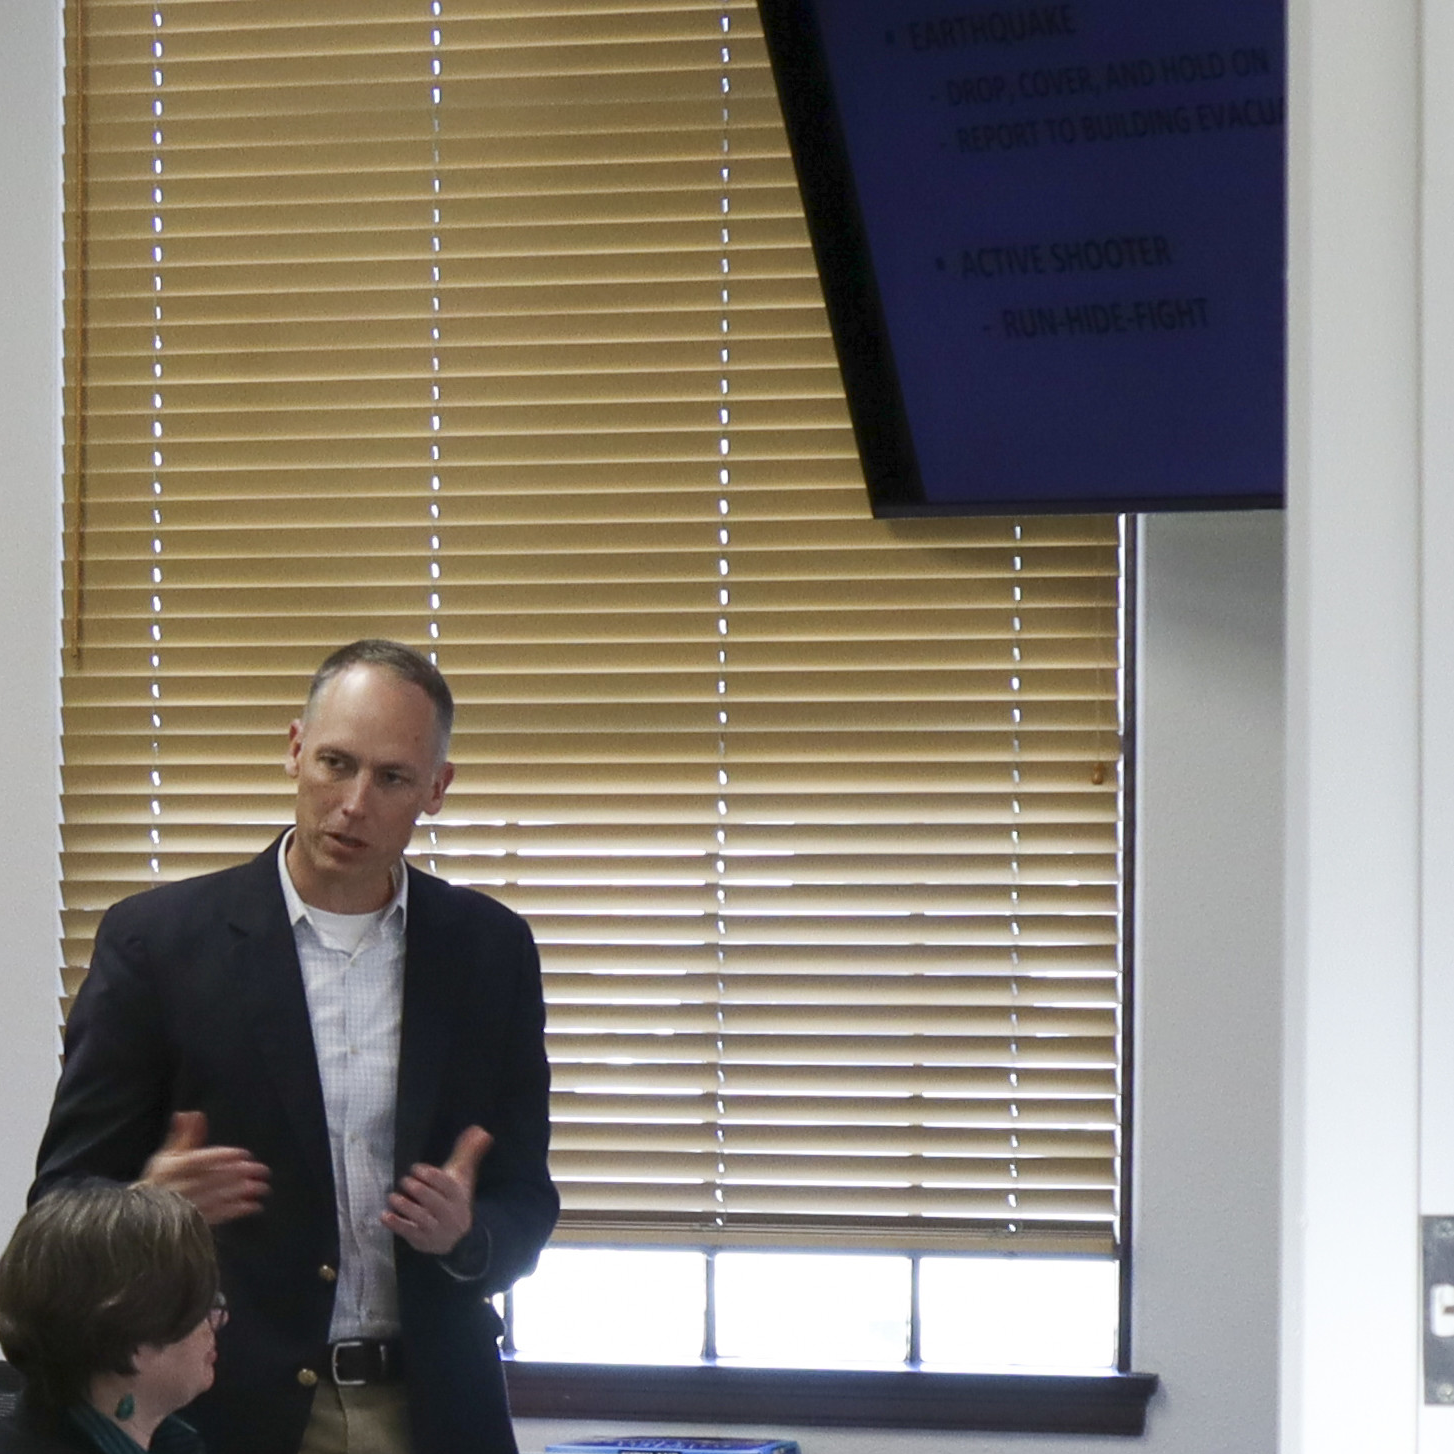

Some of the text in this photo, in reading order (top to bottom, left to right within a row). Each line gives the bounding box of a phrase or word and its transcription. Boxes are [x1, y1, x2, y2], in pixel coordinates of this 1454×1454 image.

[908, 4, 1077, 51] EARTHQUAKE
[946, 47, 1270, 106] DROP, COVER, AND HOLD ON
[957, 119, 1040, 152] REPORT
[1043, 115, 1077, 144] TO
[1081, 106, 1191, 143] BUILDING
[960, 235, 1174, 280] ACTIVE SHOOTER
[1002, 297, 1209, 339] RUN-HIDE-FIGHT
